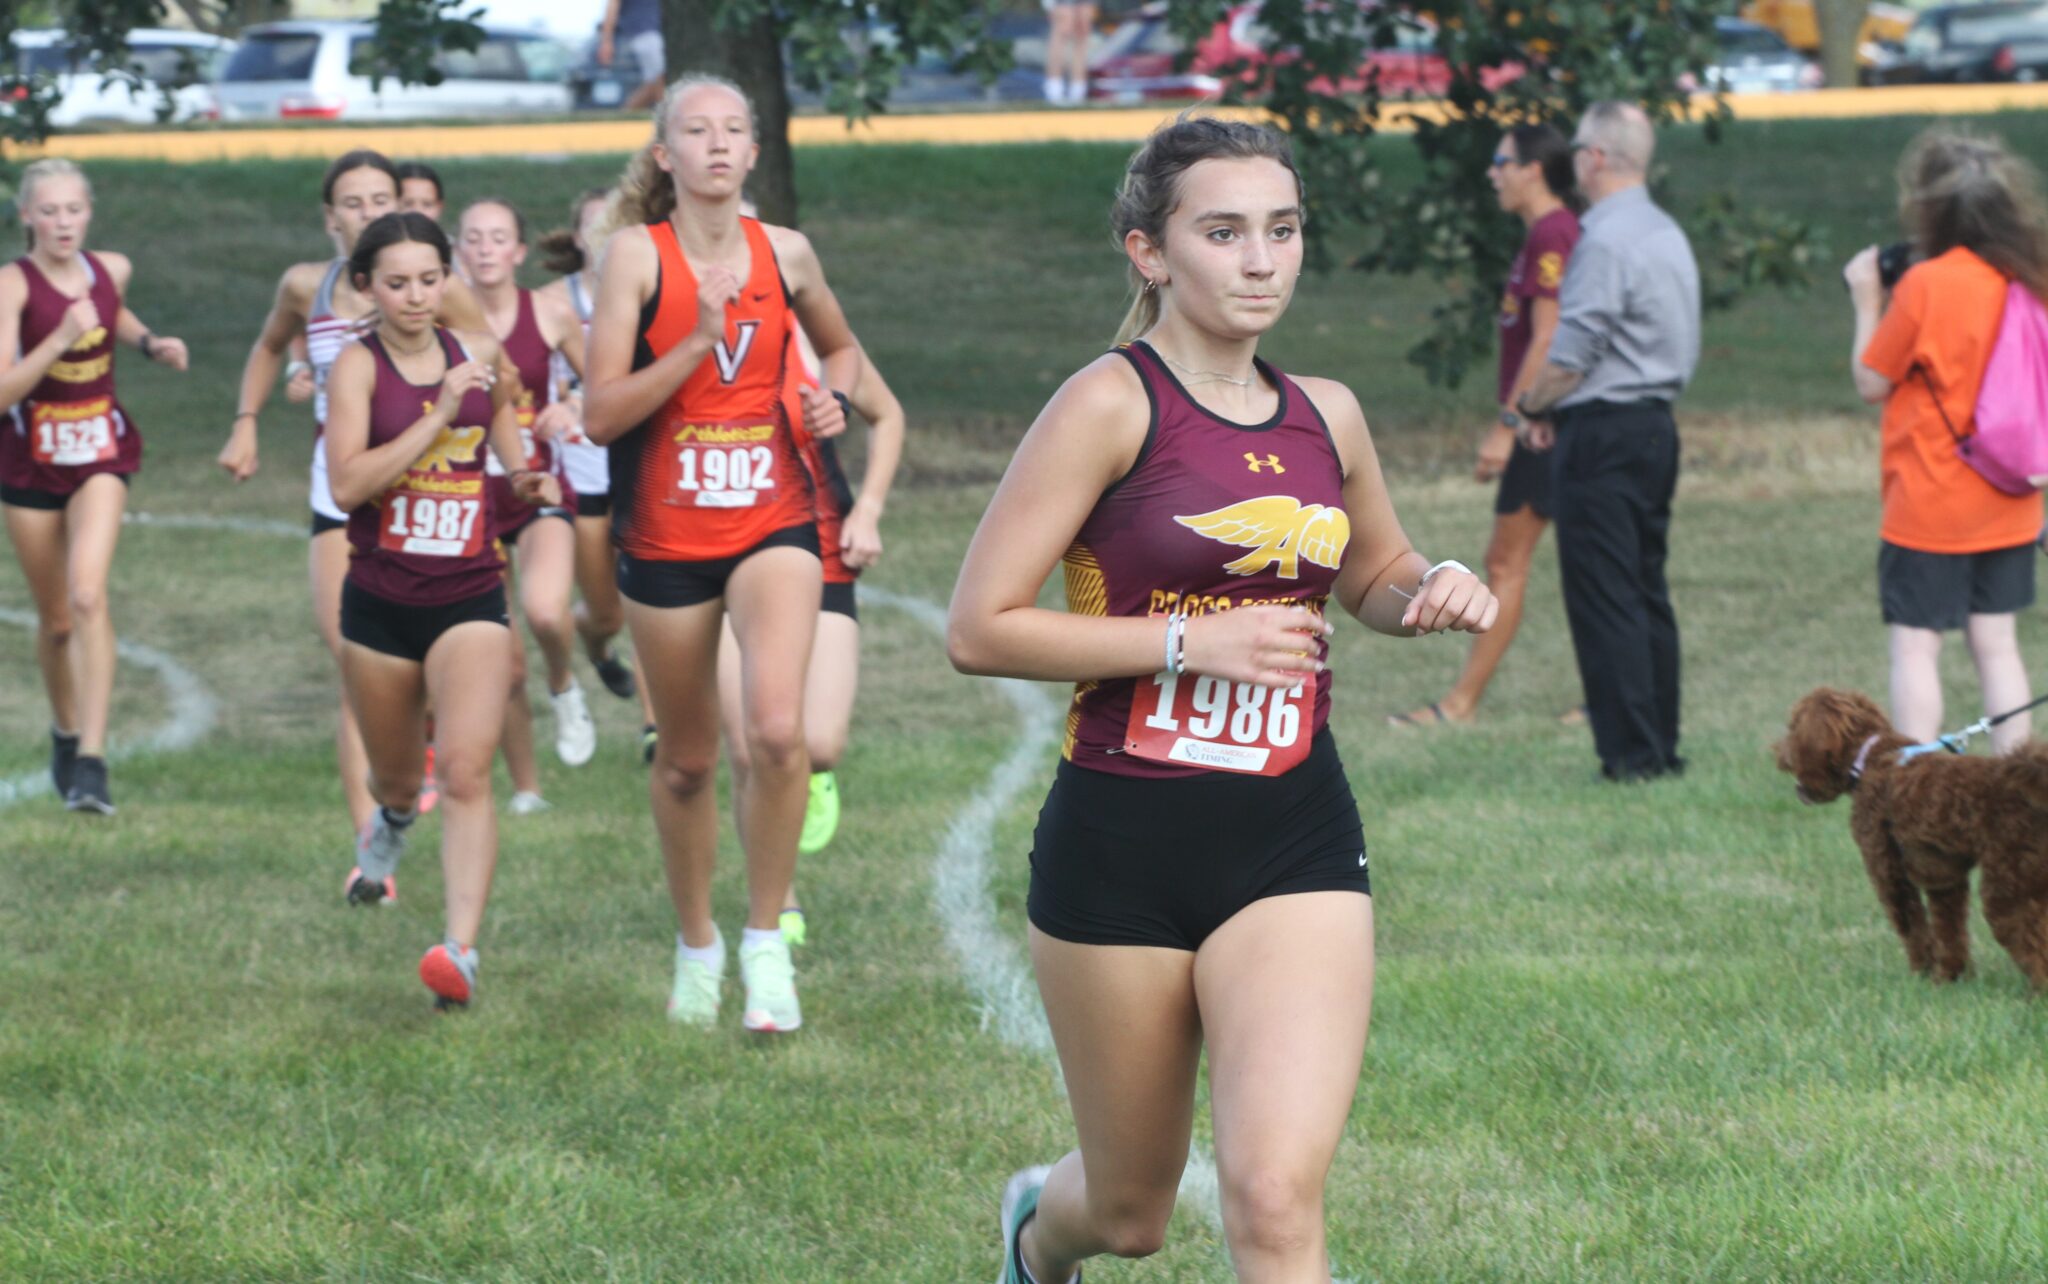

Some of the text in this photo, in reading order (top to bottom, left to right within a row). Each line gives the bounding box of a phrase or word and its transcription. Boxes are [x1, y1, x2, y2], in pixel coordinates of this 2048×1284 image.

[712, 320, 760, 385] V
[677, 445, 776, 491] 1902
[388, 495, 480, 541] 1987
[1145, 672, 1304, 748] 1986
[1200, 752, 1233, 765] TIMING
